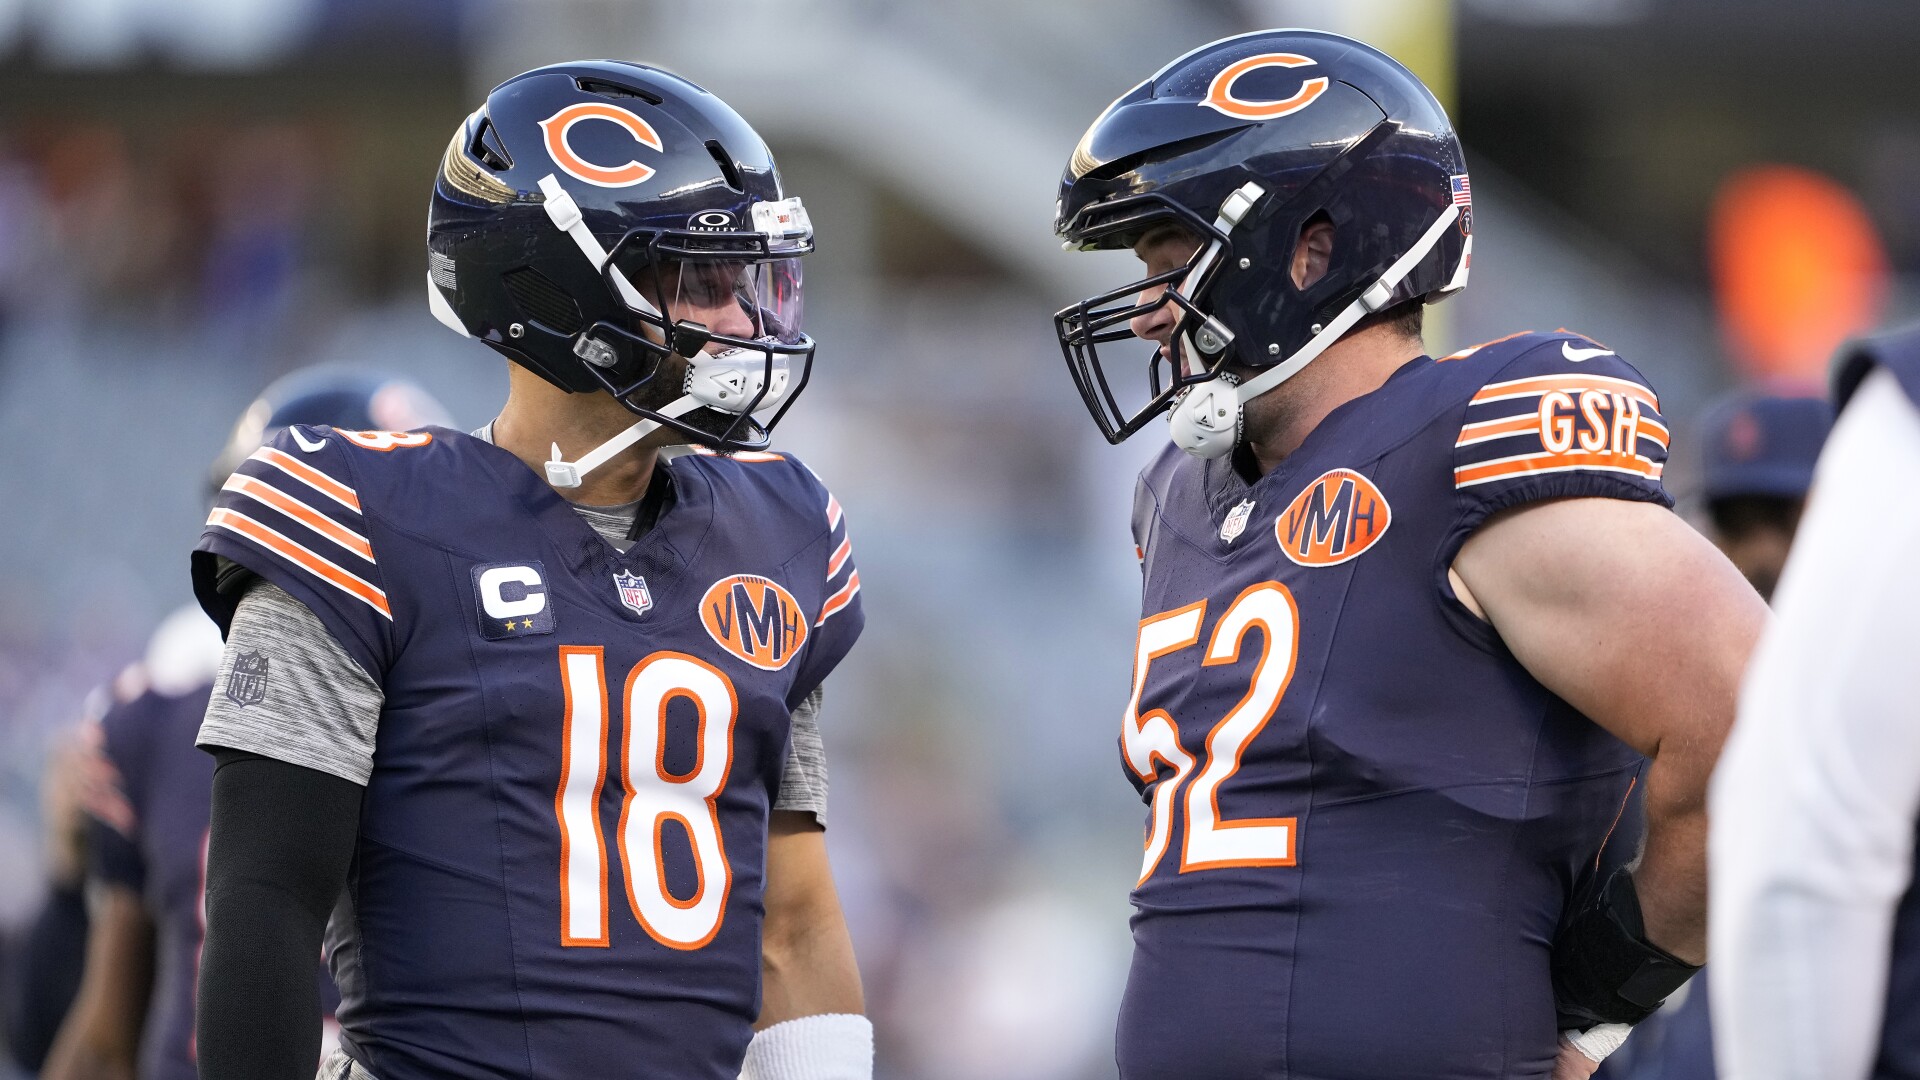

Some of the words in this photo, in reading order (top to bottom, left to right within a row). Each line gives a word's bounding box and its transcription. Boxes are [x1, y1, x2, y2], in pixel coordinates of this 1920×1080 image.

[1198, 52, 1329, 121] C
[537, 102, 664, 188] C
[1538, 386, 1641, 460] GSH
[1288, 478, 1375, 557] VMH
[480, 566, 546, 619] C
[623, 588, 648, 606] NFL
[713, 583, 798, 662] VMH
[230, 673, 263, 700] NFL
[1122, 580, 1298, 890] 52
[556, 645, 739, 951] 18
